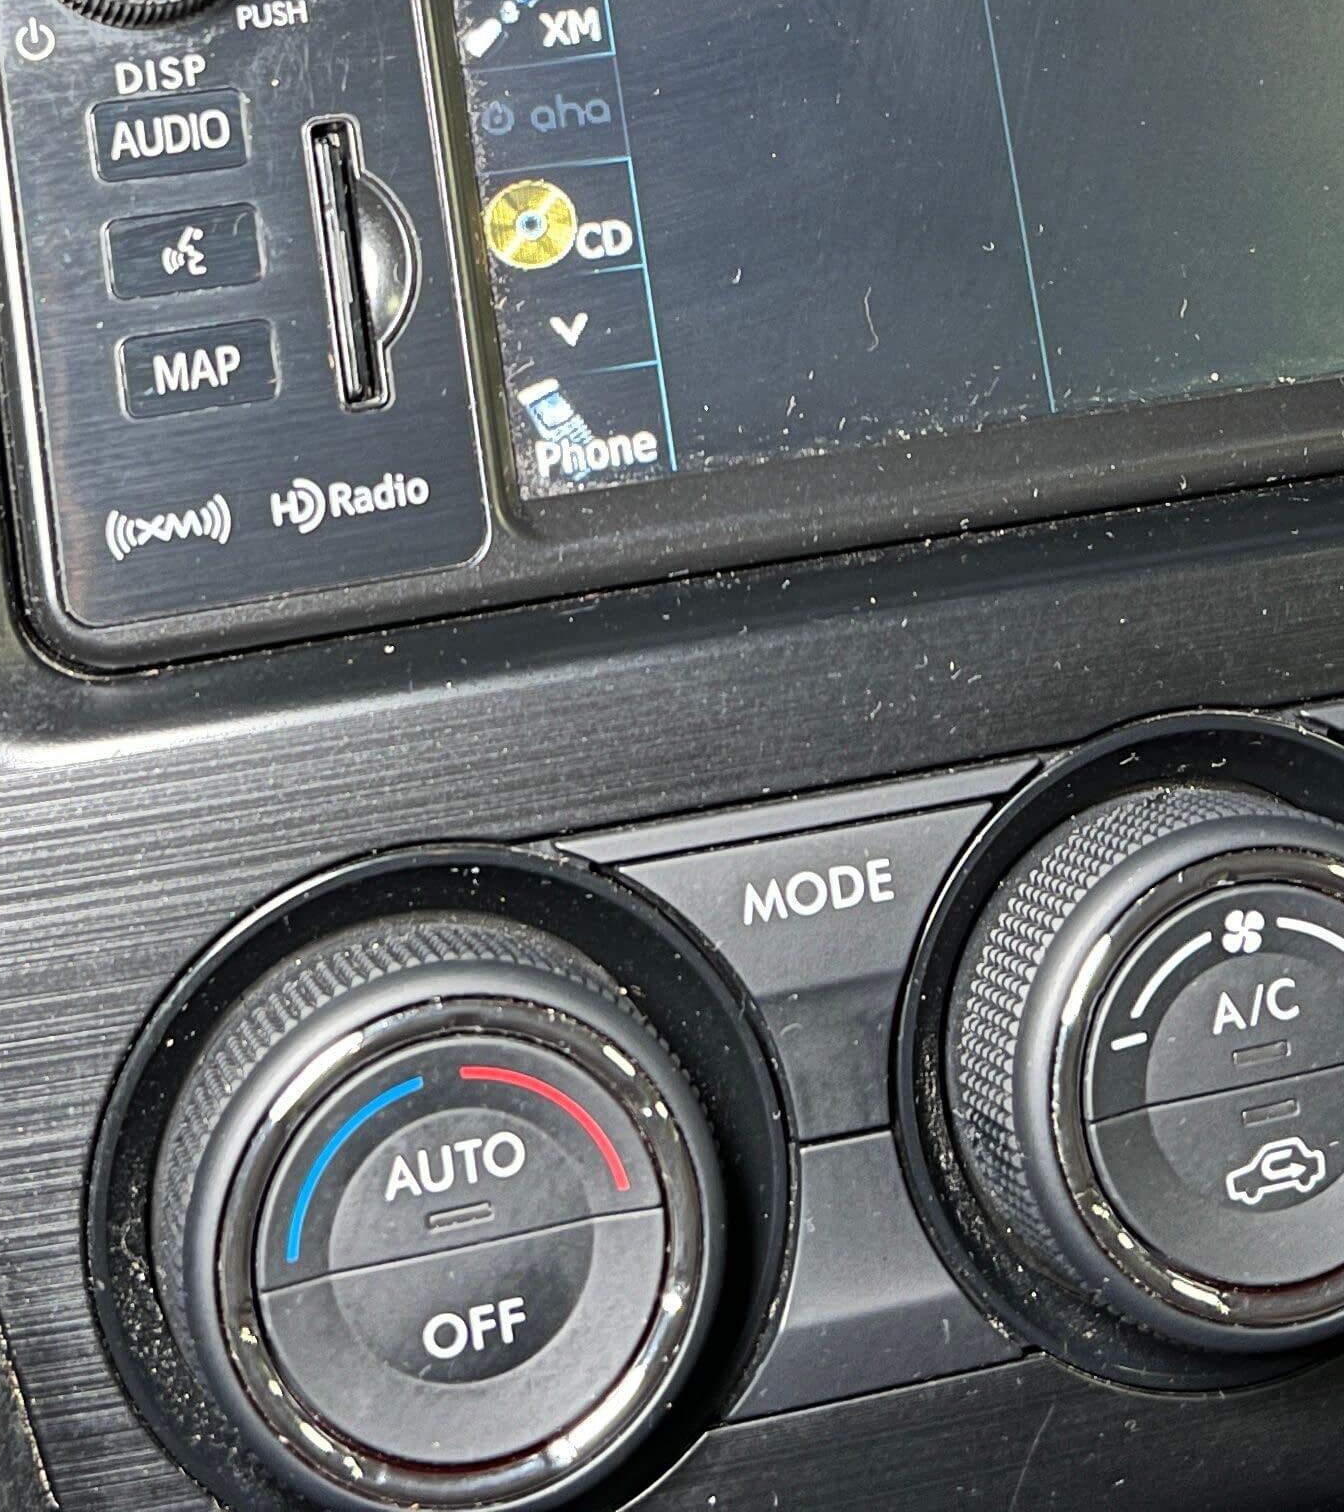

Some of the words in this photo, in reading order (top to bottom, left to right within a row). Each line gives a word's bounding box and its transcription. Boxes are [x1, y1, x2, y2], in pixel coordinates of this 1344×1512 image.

[237, 0, 309, 31] PUSH
[538, 6, 602, 48] XM
[115, 54, 207, 95] DISP
[110, 109, 231, 161] AUDIO
[530, 94, 612, 134] aha
[576, 219, 633, 259] CD
[152, 344, 241, 396] MAP
[534, 431, 658, 477] Phone
[328, 472, 430, 518] Radio
[742, 858, 895, 926] MODE
[1211, 976, 1302, 1036] A/C
[383, 1131, 527, 1203] AUTO
[421, 1296, 528, 1360] OFF
